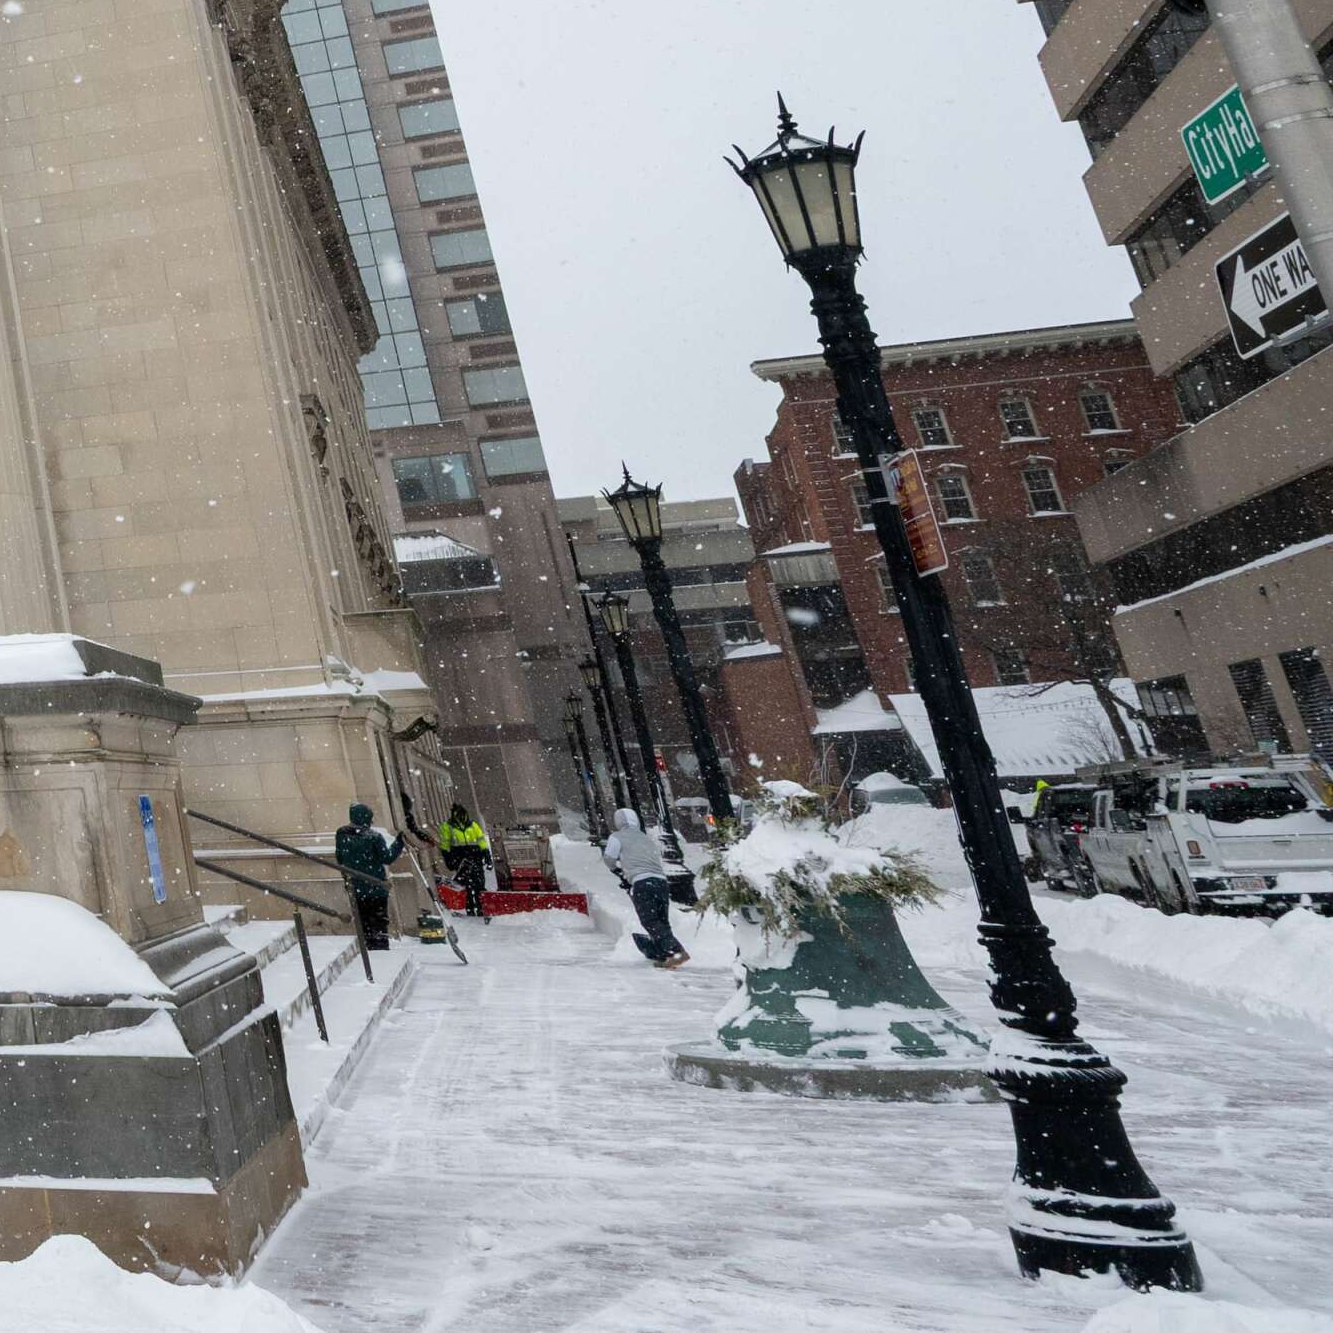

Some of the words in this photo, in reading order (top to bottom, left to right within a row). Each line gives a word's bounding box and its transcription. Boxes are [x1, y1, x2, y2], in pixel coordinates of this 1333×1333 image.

[1188, 120, 1239, 179] City
[1219, 91, 1261, 158] Hal
[1251, 260, 1288, 308] ONE
[1281, 245, 1316, 289] WA
